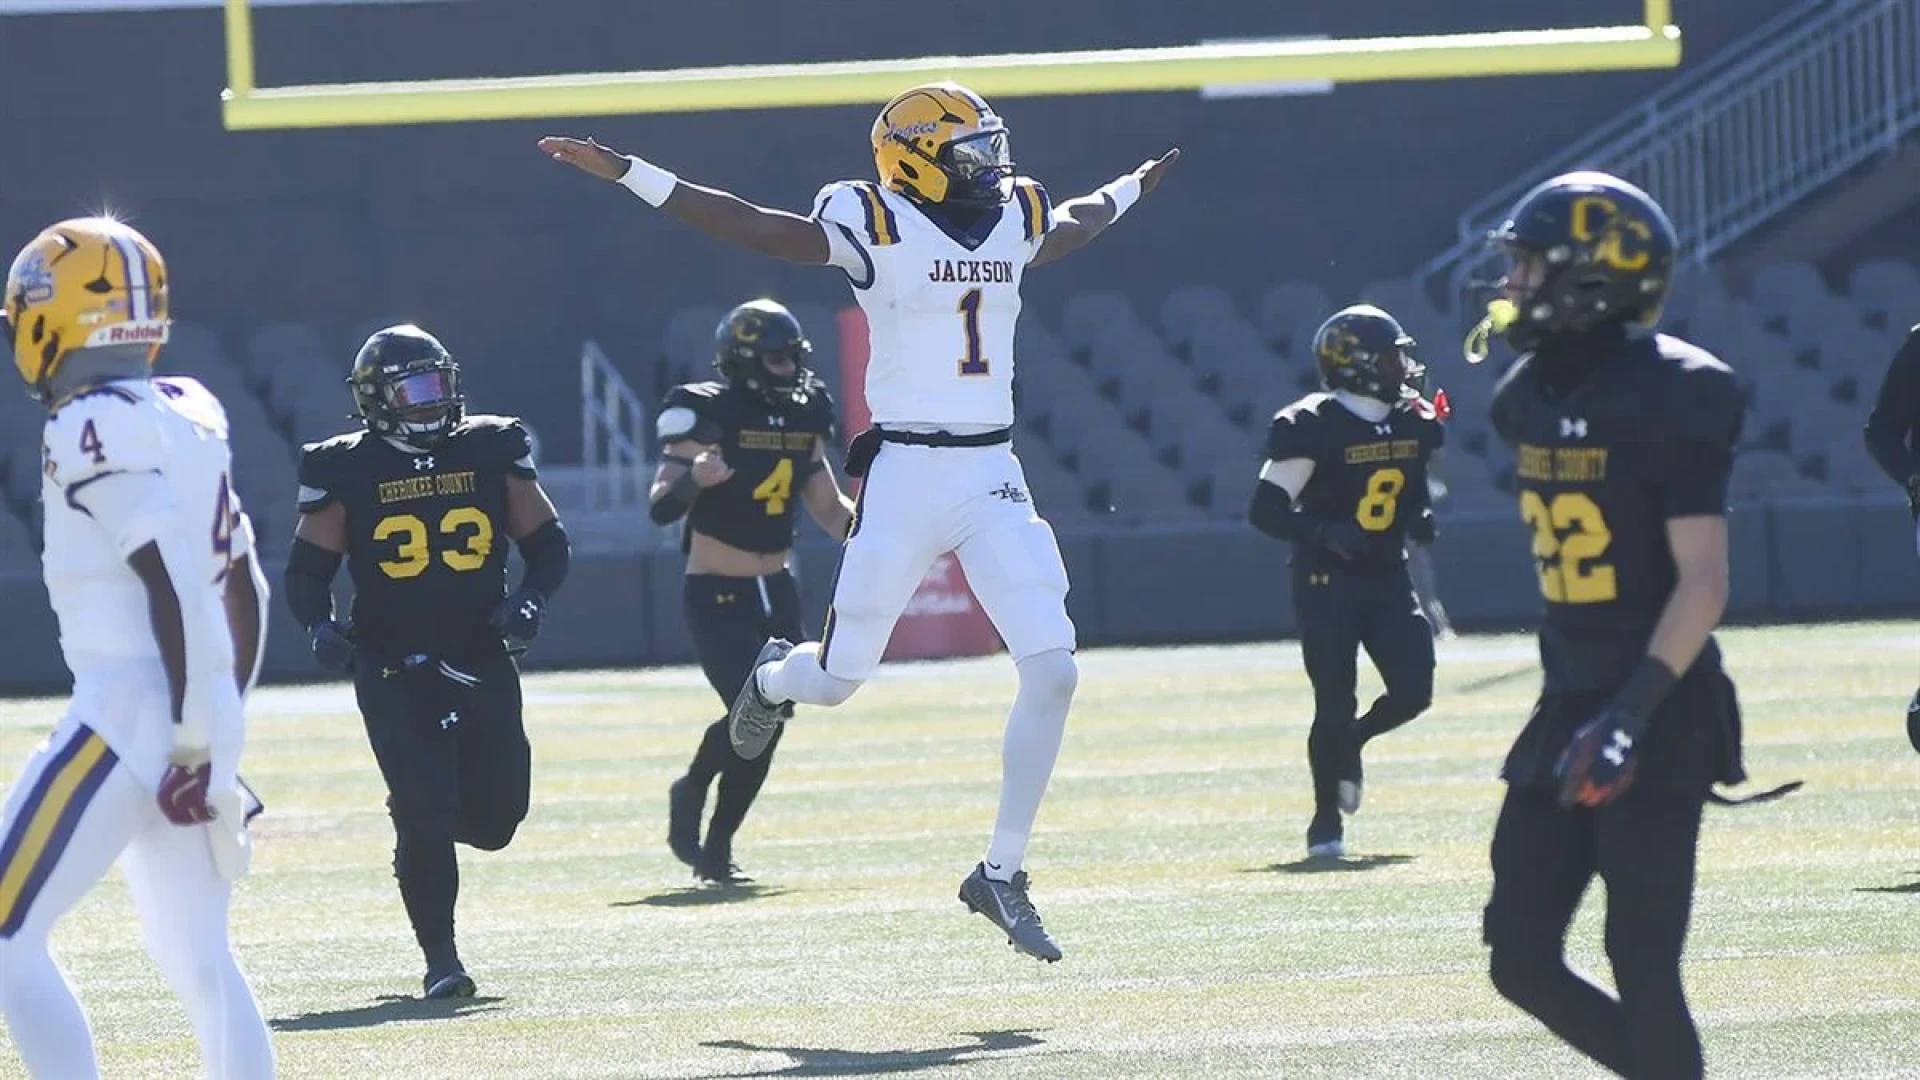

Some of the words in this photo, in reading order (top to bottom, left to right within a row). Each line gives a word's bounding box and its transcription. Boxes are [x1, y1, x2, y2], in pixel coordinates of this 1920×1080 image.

[928, 258, 1014, 284] JACKSON
[957, 286, 990, 377] 1
[79, 418, 106, 465] 4
[752, 457, 794, 516] 4
[1356, 467, 1406, 533] 8
[372, 505, 494, 580] 33
